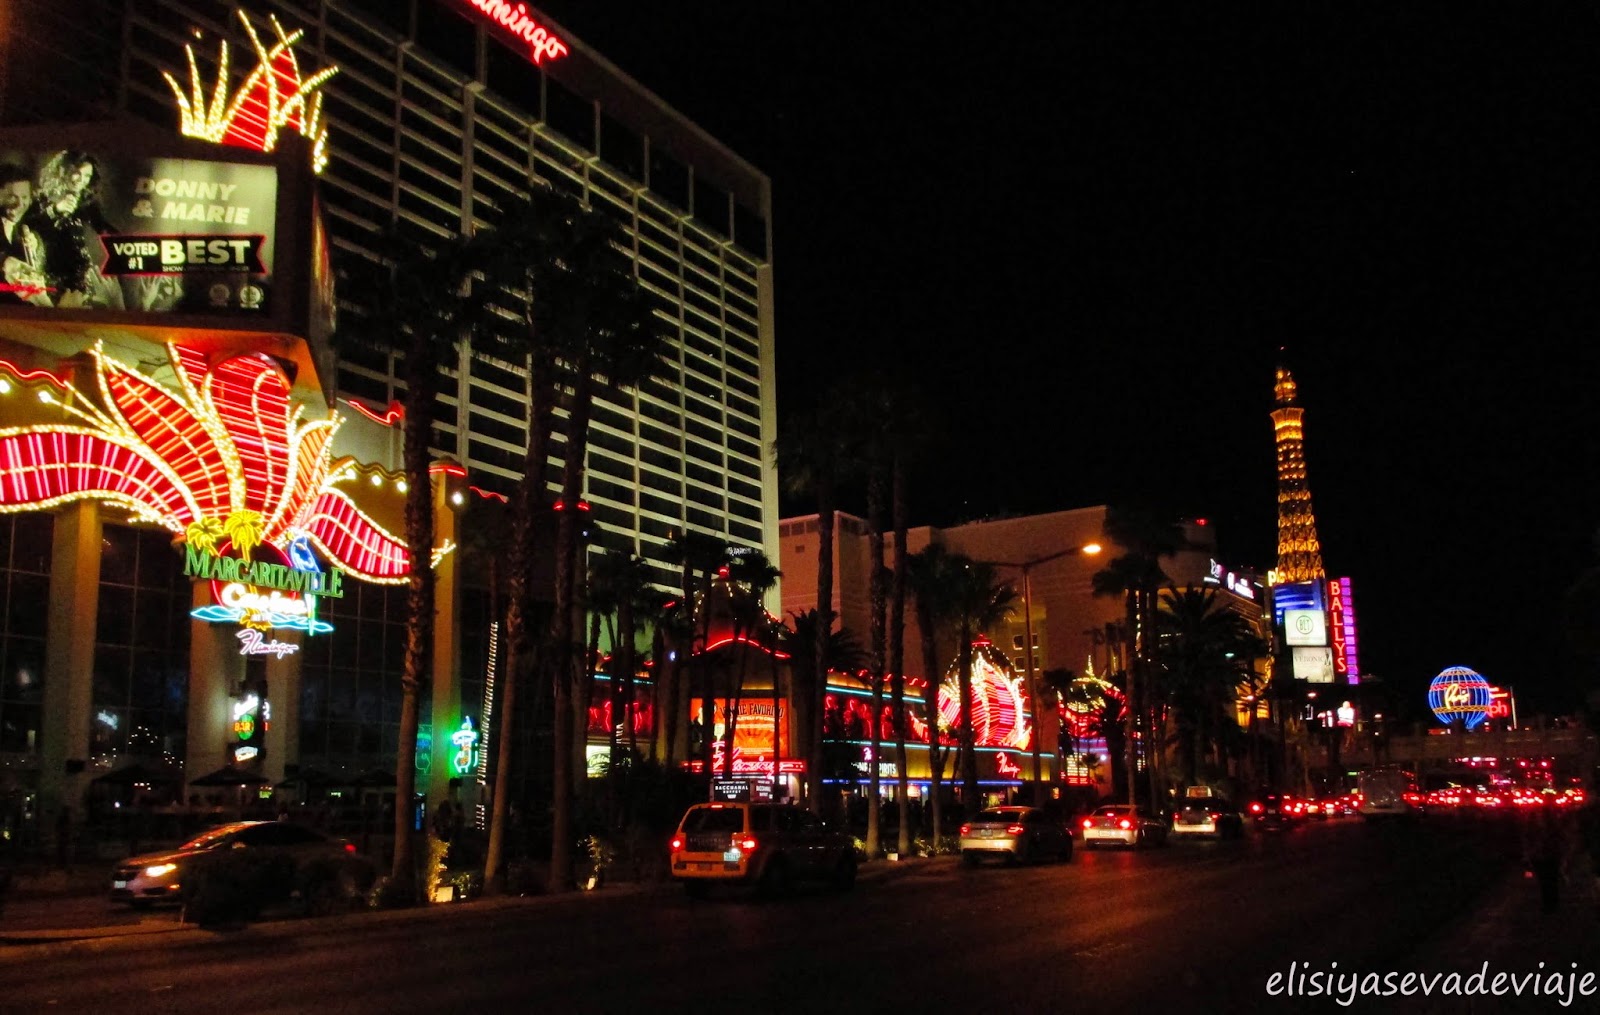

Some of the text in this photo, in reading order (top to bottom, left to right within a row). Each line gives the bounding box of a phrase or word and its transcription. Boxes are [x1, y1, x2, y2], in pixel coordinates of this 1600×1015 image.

[134, 177, 237, 200] DONNY
[132, 200, 250, 225] & MARIE
[113, 243, 158, 256] VOTED
[161, 239, 250, 264] BEST
[128, 257, 143, 269] #1
[183, 542, 344, 598] MARGARITAVILLE
[1330, 581, 1347, 673] BALLYS
[235, 628, 299, 659] Flamingo
